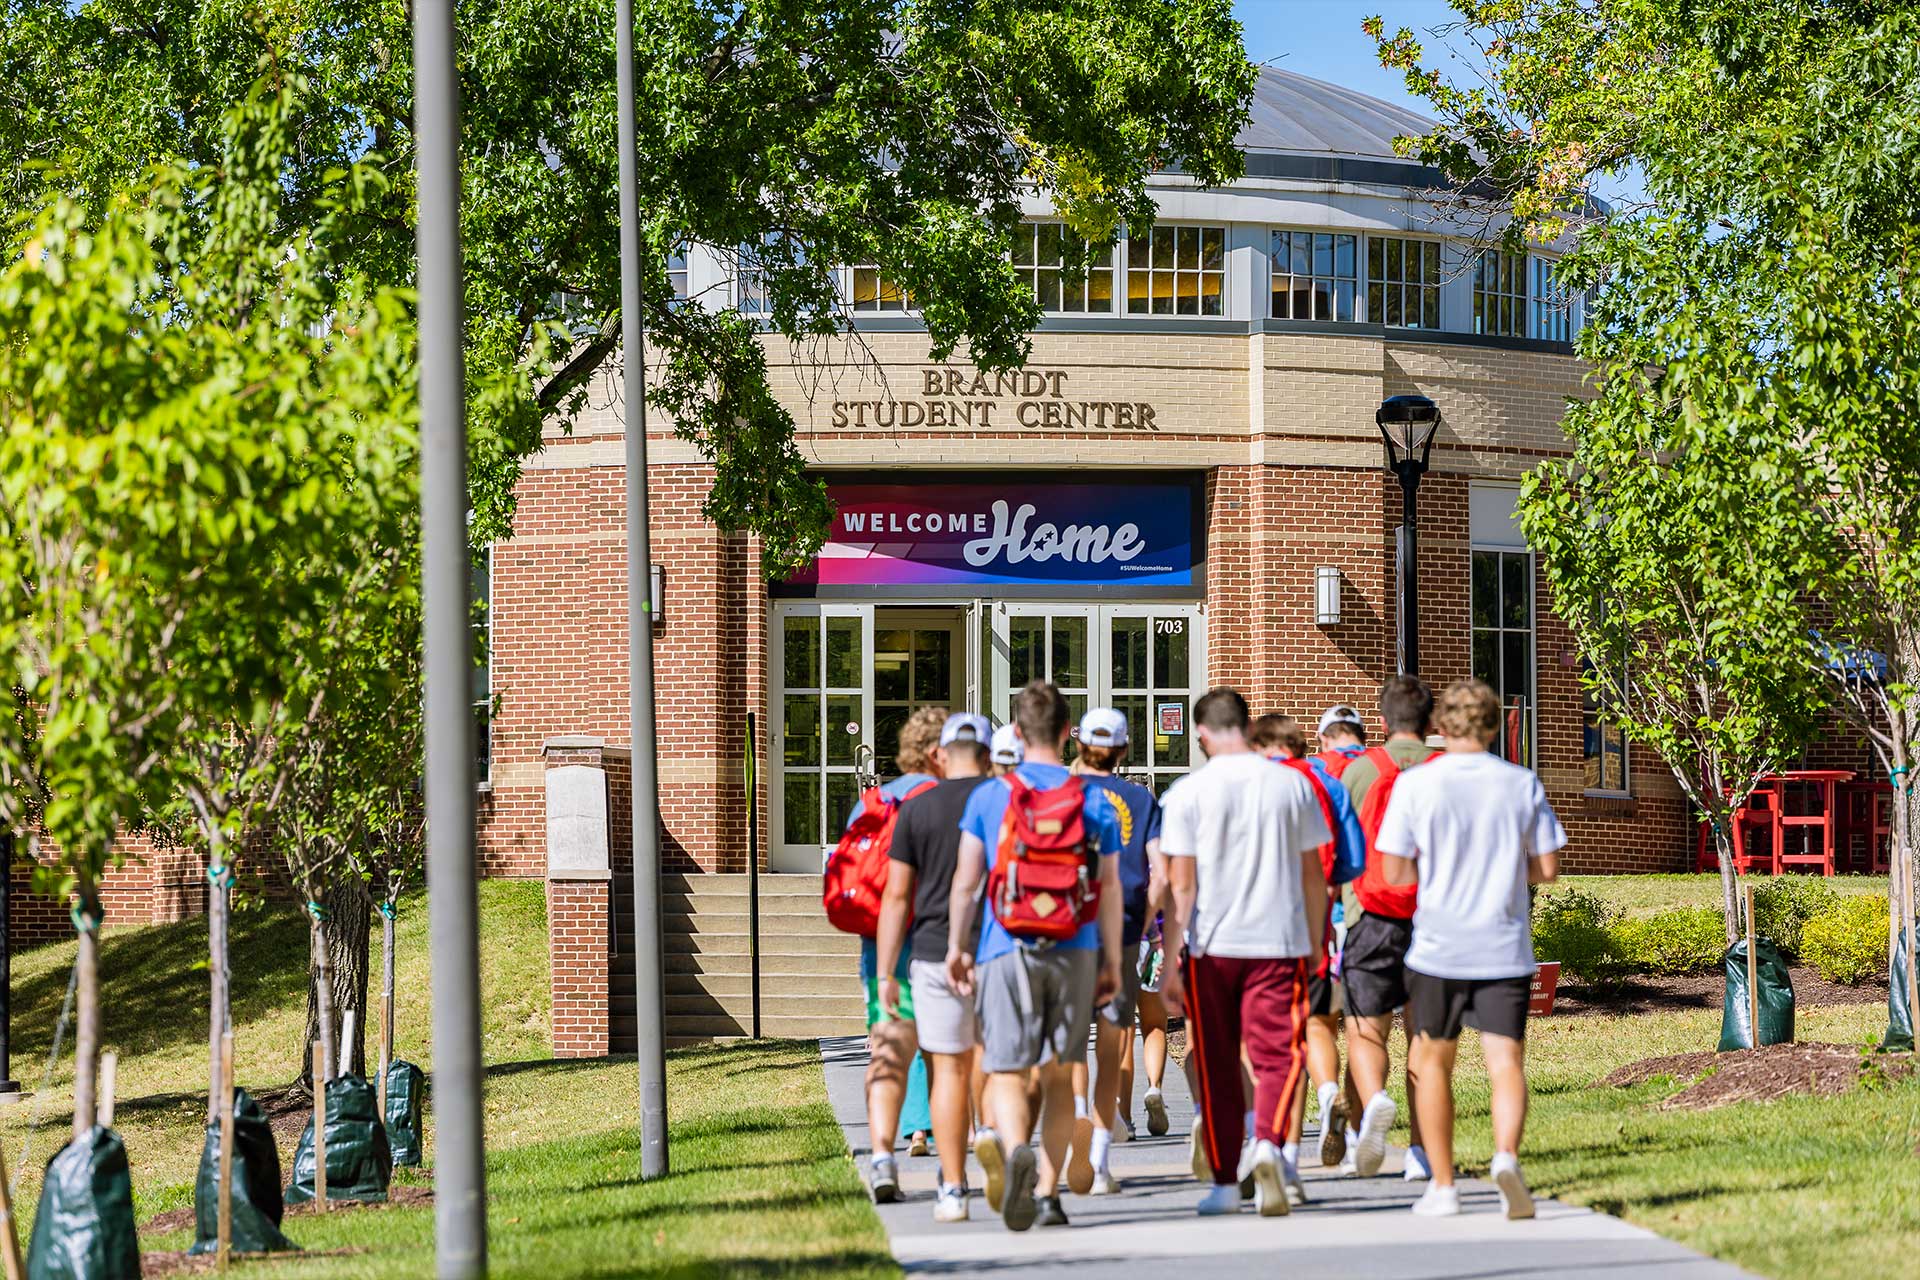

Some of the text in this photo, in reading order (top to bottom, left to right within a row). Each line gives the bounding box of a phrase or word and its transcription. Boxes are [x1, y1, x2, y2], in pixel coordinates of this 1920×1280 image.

[922, 370, 1068, 398] BRANDT
[832, 401, 1159, 430] STUDENT CENTER
[844, 500, 1145, 566] WELCOME Home
[1155, 620, 1183, 634] 703
